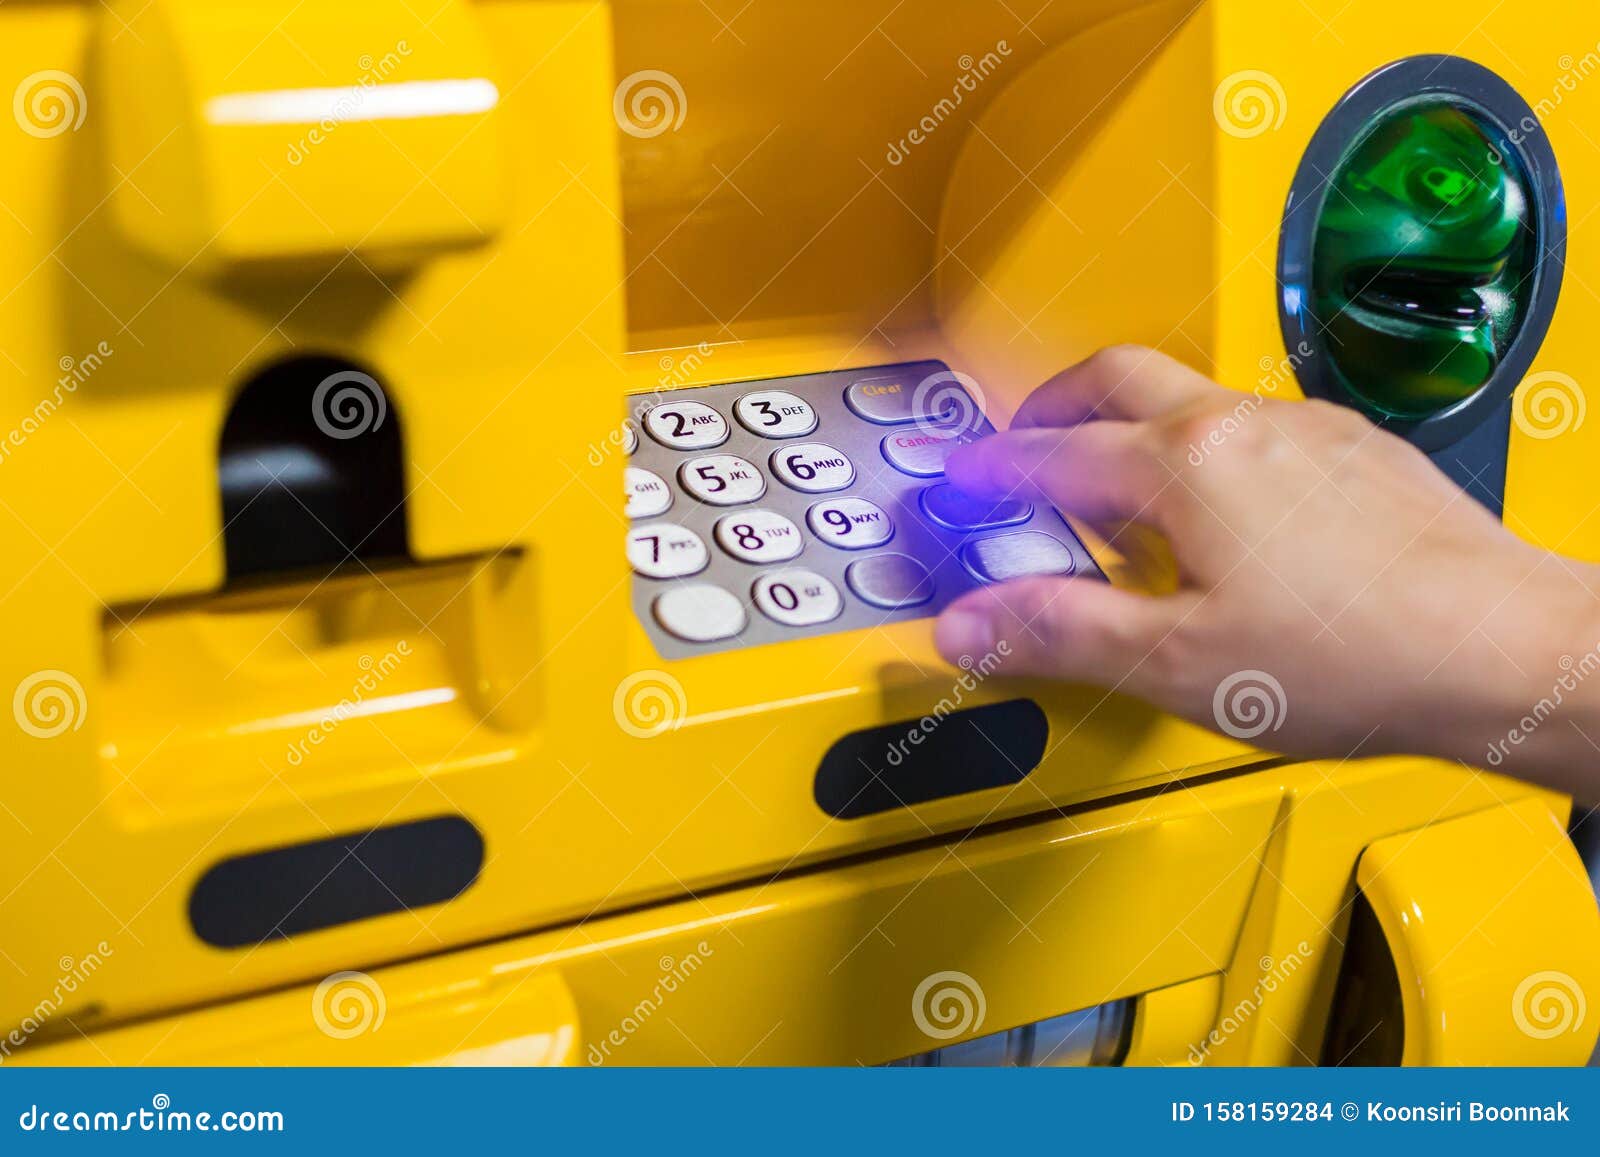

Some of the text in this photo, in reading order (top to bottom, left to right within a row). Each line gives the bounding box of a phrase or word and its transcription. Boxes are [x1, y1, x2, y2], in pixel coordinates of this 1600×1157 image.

[862, 384, 903, 398] Clear
[660, 411, 718, 438] 2 ABC
[751, 401, 806, 426] 3 DEF
[896, 434, 944, 448] Cance
[696, 466, 752, 492] 5 JKL
[786, 454, 845, 480] 6 MNO
[822, 509, 880, 535] 9 WXY
[634, 535, 660, 563] 7
[732, 524, 791, 550] 8 TUV
